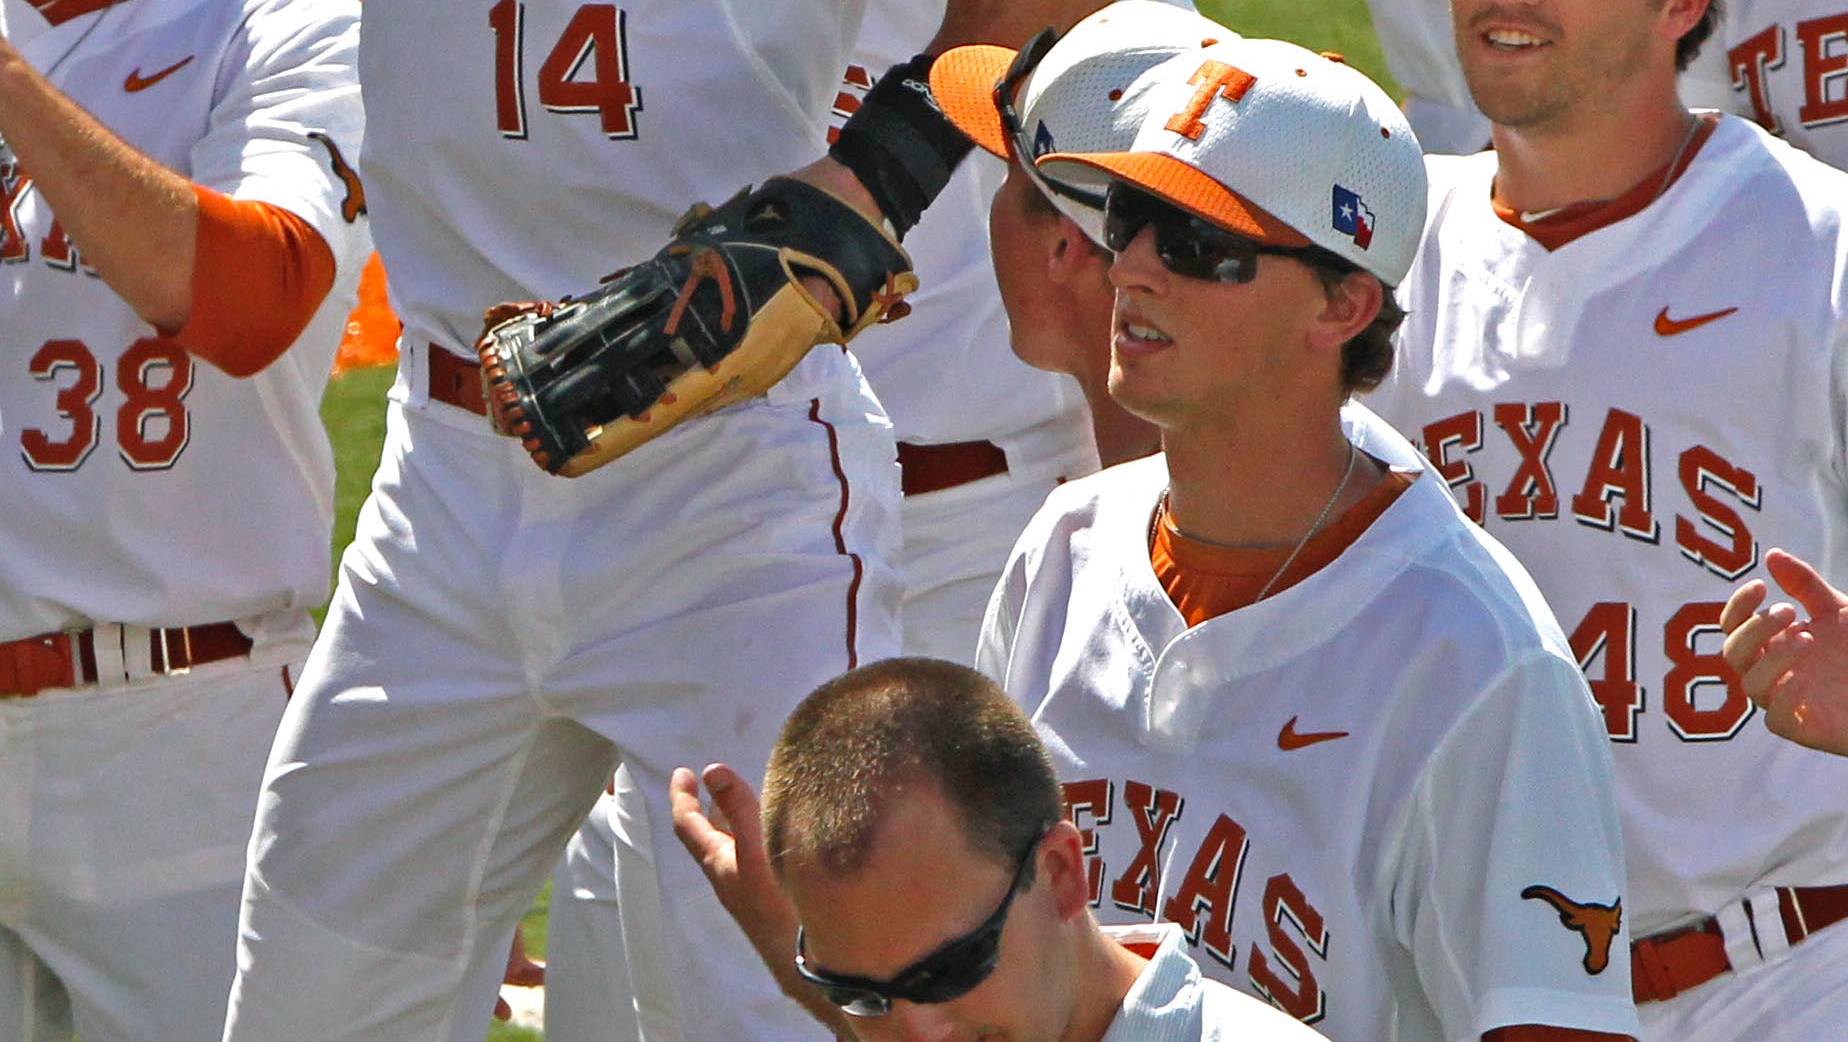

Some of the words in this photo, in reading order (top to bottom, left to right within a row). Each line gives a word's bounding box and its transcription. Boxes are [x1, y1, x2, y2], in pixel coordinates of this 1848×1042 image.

[1164, 60, 1258, 141] T
[19, 337, 194, 471] 38
[1415, 401, 1761, 581] EXAS
[1568, 601, 1756, 743] 48
[1060, 778, 1330, 1026] EXAS
